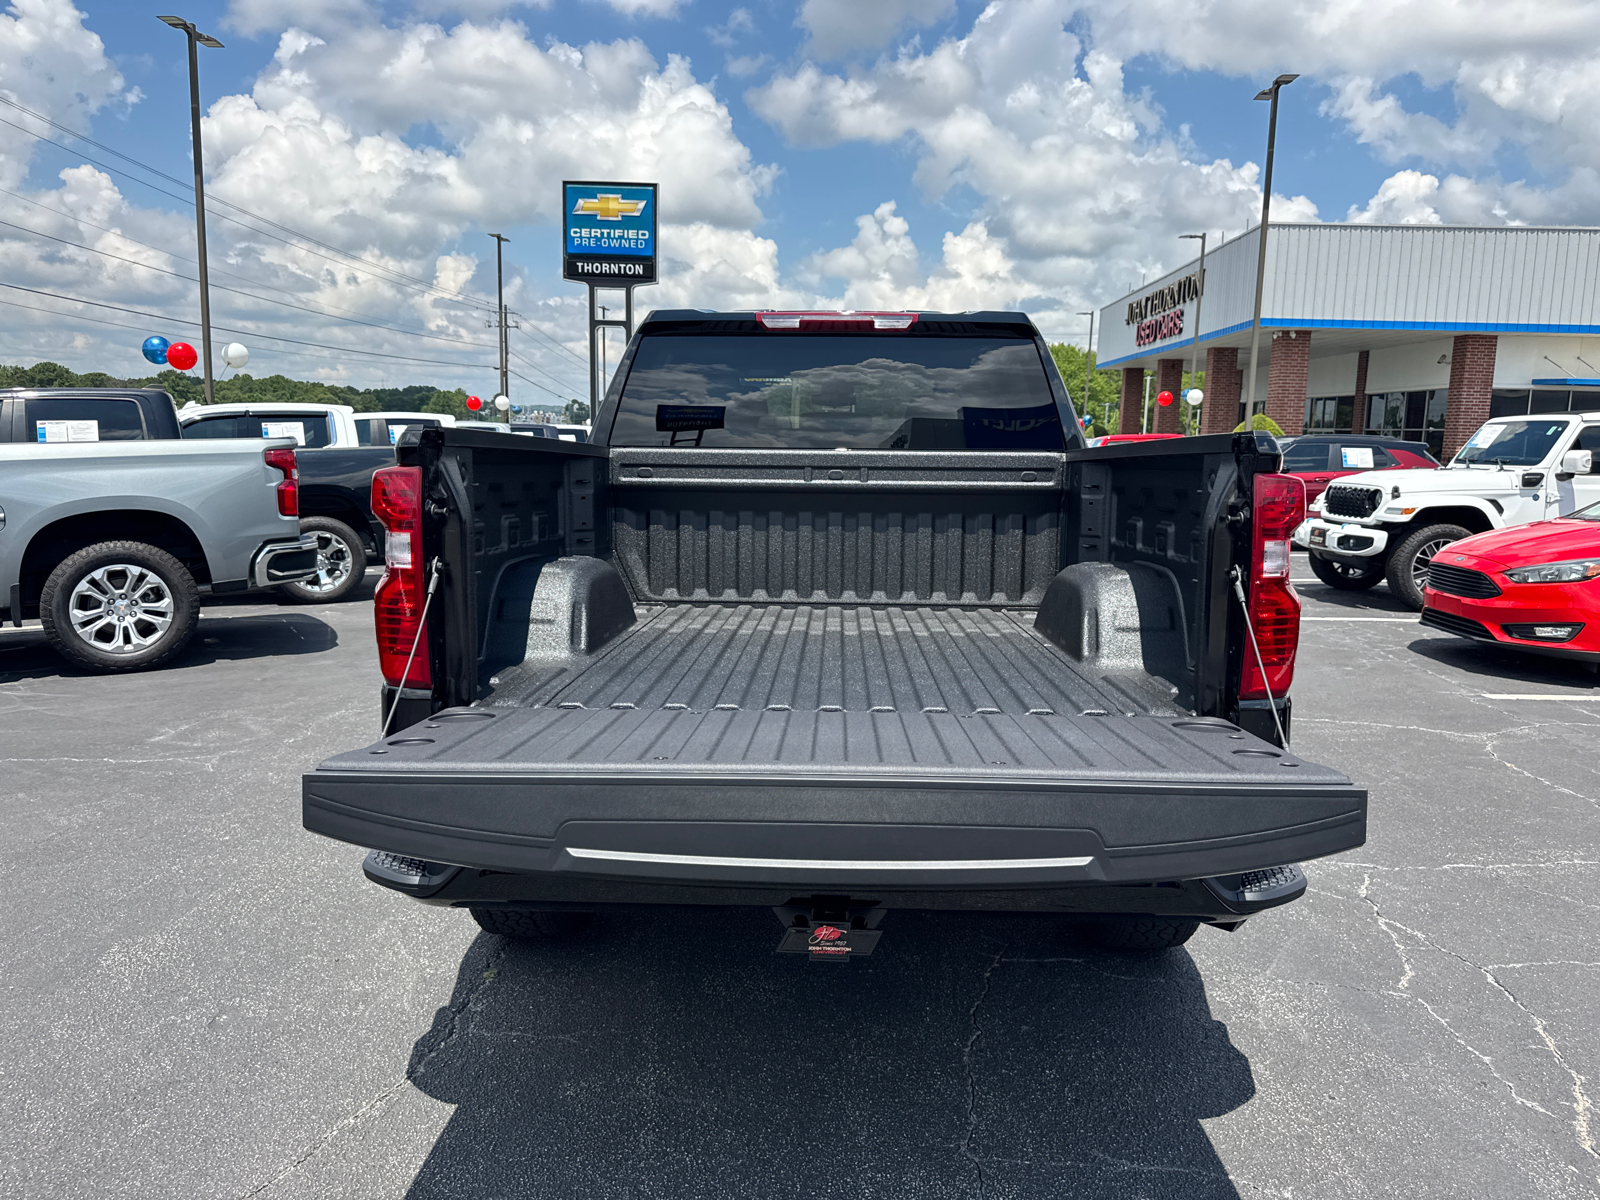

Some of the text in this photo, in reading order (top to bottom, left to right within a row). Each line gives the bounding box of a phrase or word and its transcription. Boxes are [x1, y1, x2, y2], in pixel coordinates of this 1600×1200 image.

[570, 228, 649, 239] CERTIFIED
[574, 238, 645, 248] PRE-OWNED
[576, 262, 643, 275] THORNTON
[1135, 309, 1184, 347] USED CARS
